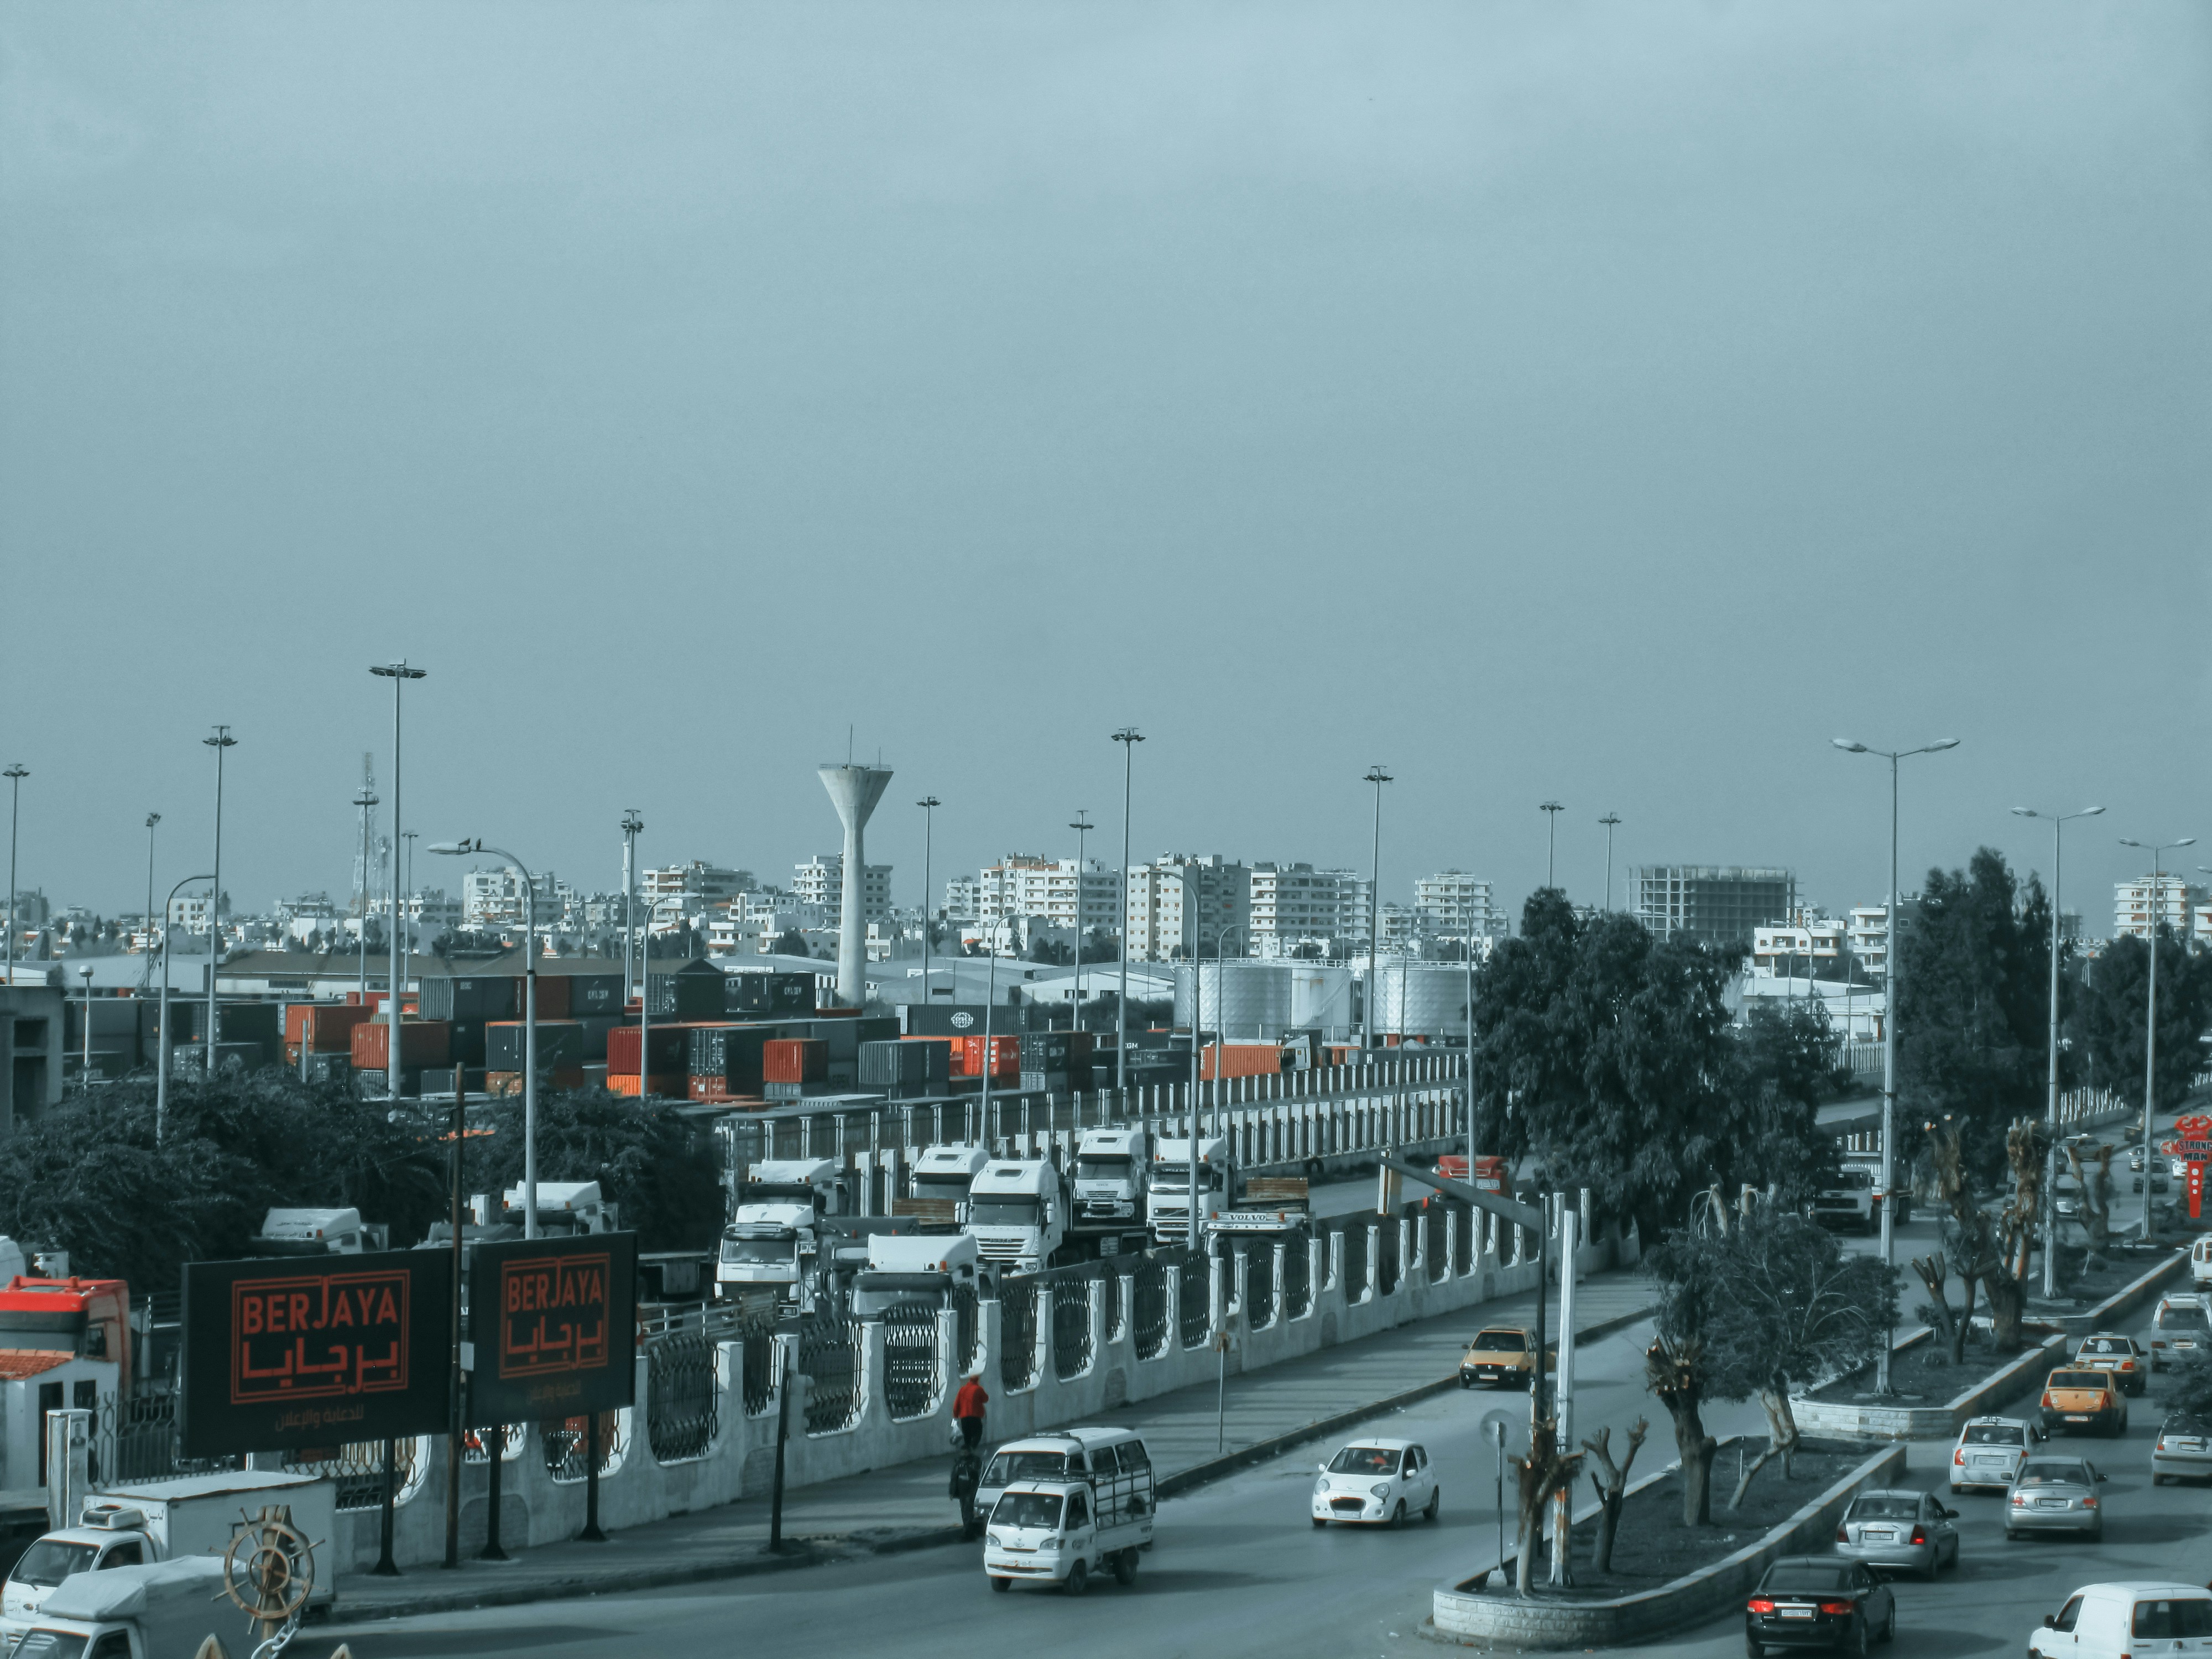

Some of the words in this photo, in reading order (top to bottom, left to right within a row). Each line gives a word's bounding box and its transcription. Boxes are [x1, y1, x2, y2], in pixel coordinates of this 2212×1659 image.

[2179, 1141, 2212, 1151] STRONG
[243, 1276, 398, 1335] BERJAYA
[508, 1258, 602, 1312] BERJAYA
[242, 1337, 398, 1394] برجايا
[507, 1315, 602, 1370] برجايا
[323, 1404, 364, 1425] للدعاية
